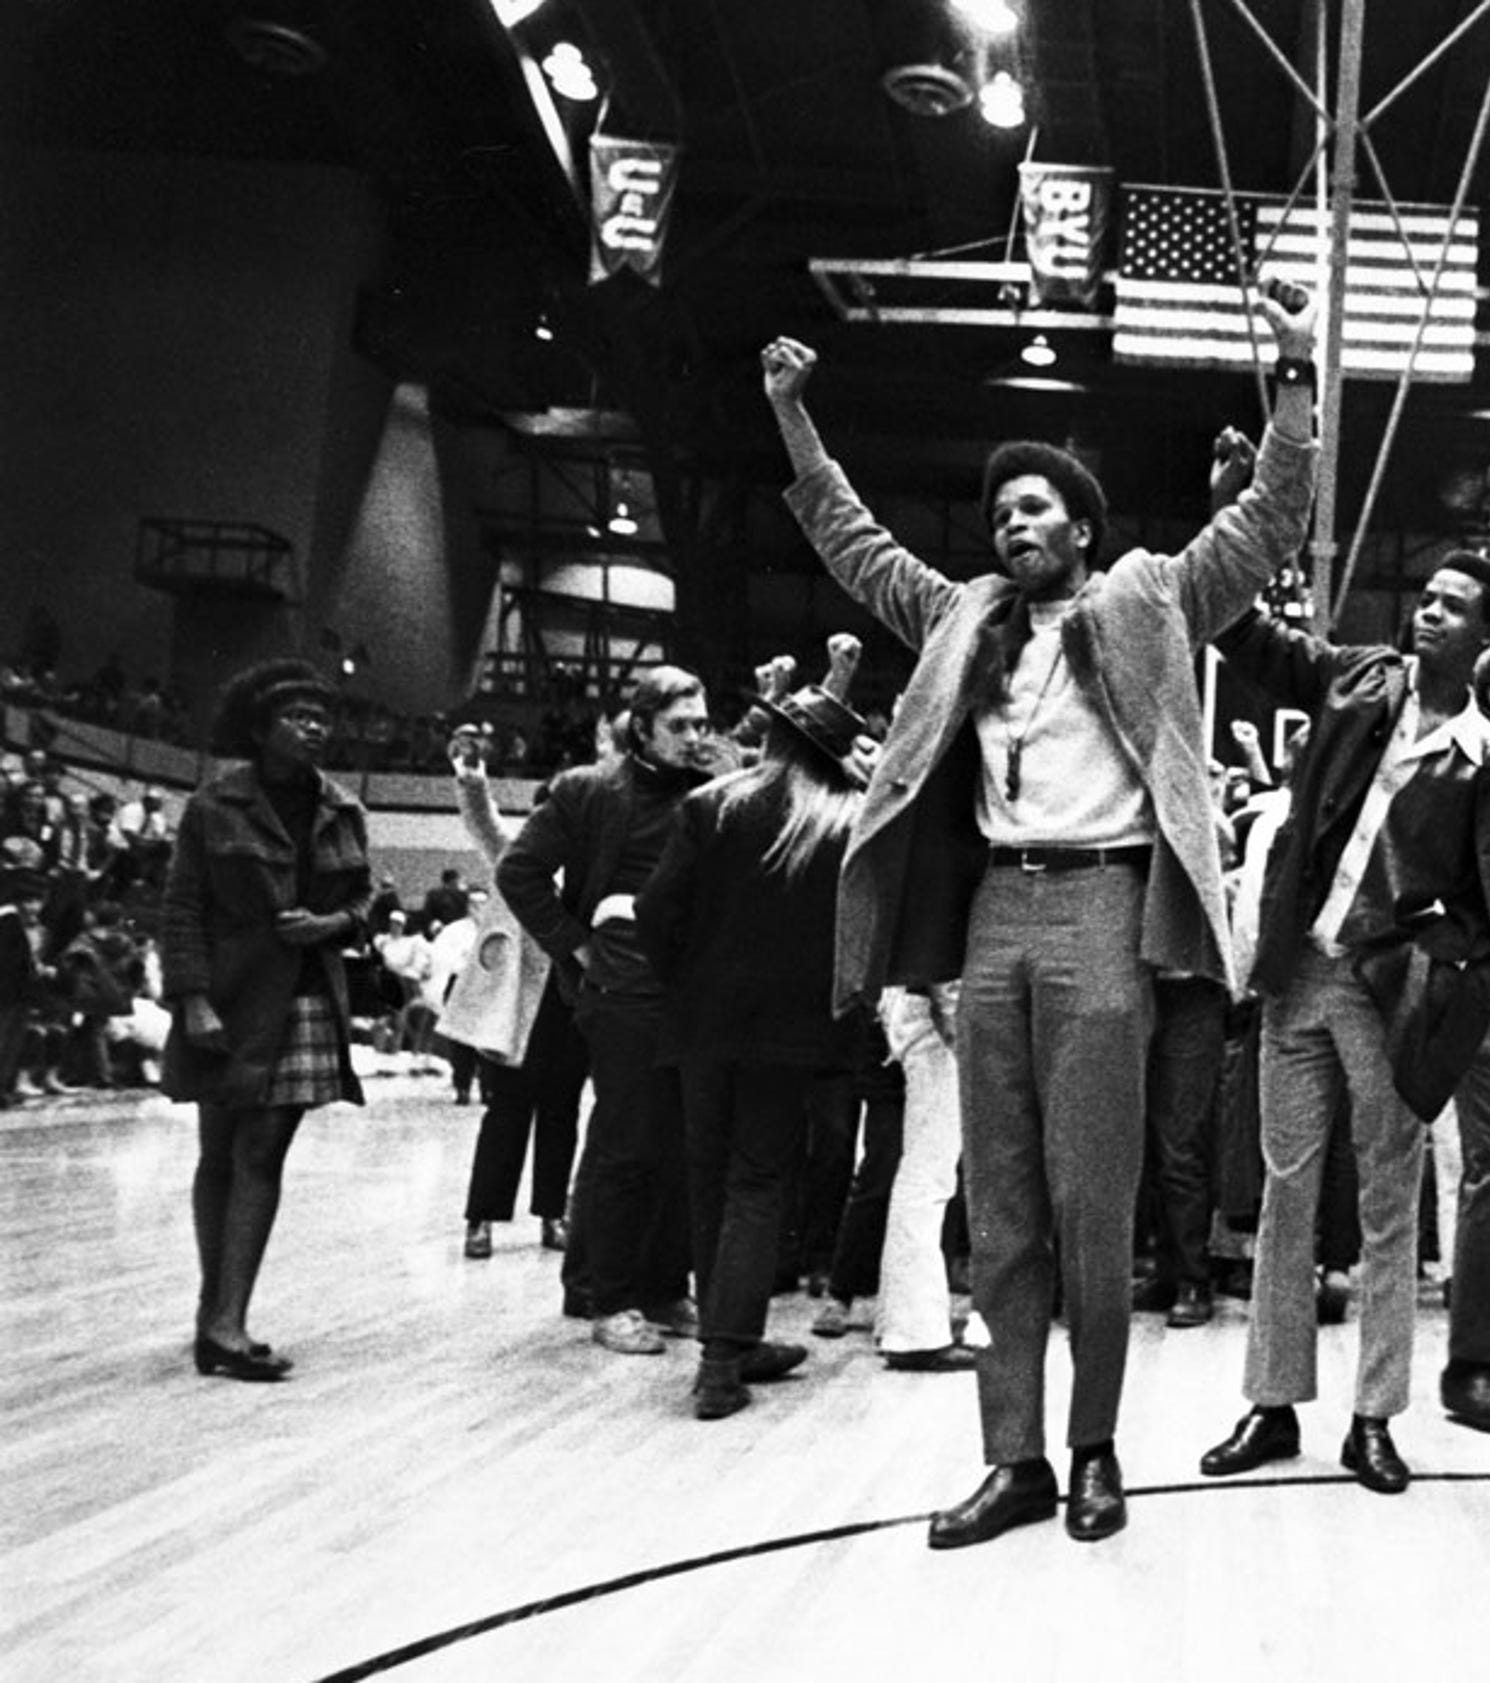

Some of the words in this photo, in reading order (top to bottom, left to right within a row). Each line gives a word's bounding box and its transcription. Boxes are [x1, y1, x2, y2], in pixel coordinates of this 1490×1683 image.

[608, 159, 662, 194] U
[601, 214, 657, 250] U
[1035, 180, 1092, 280] BYU
